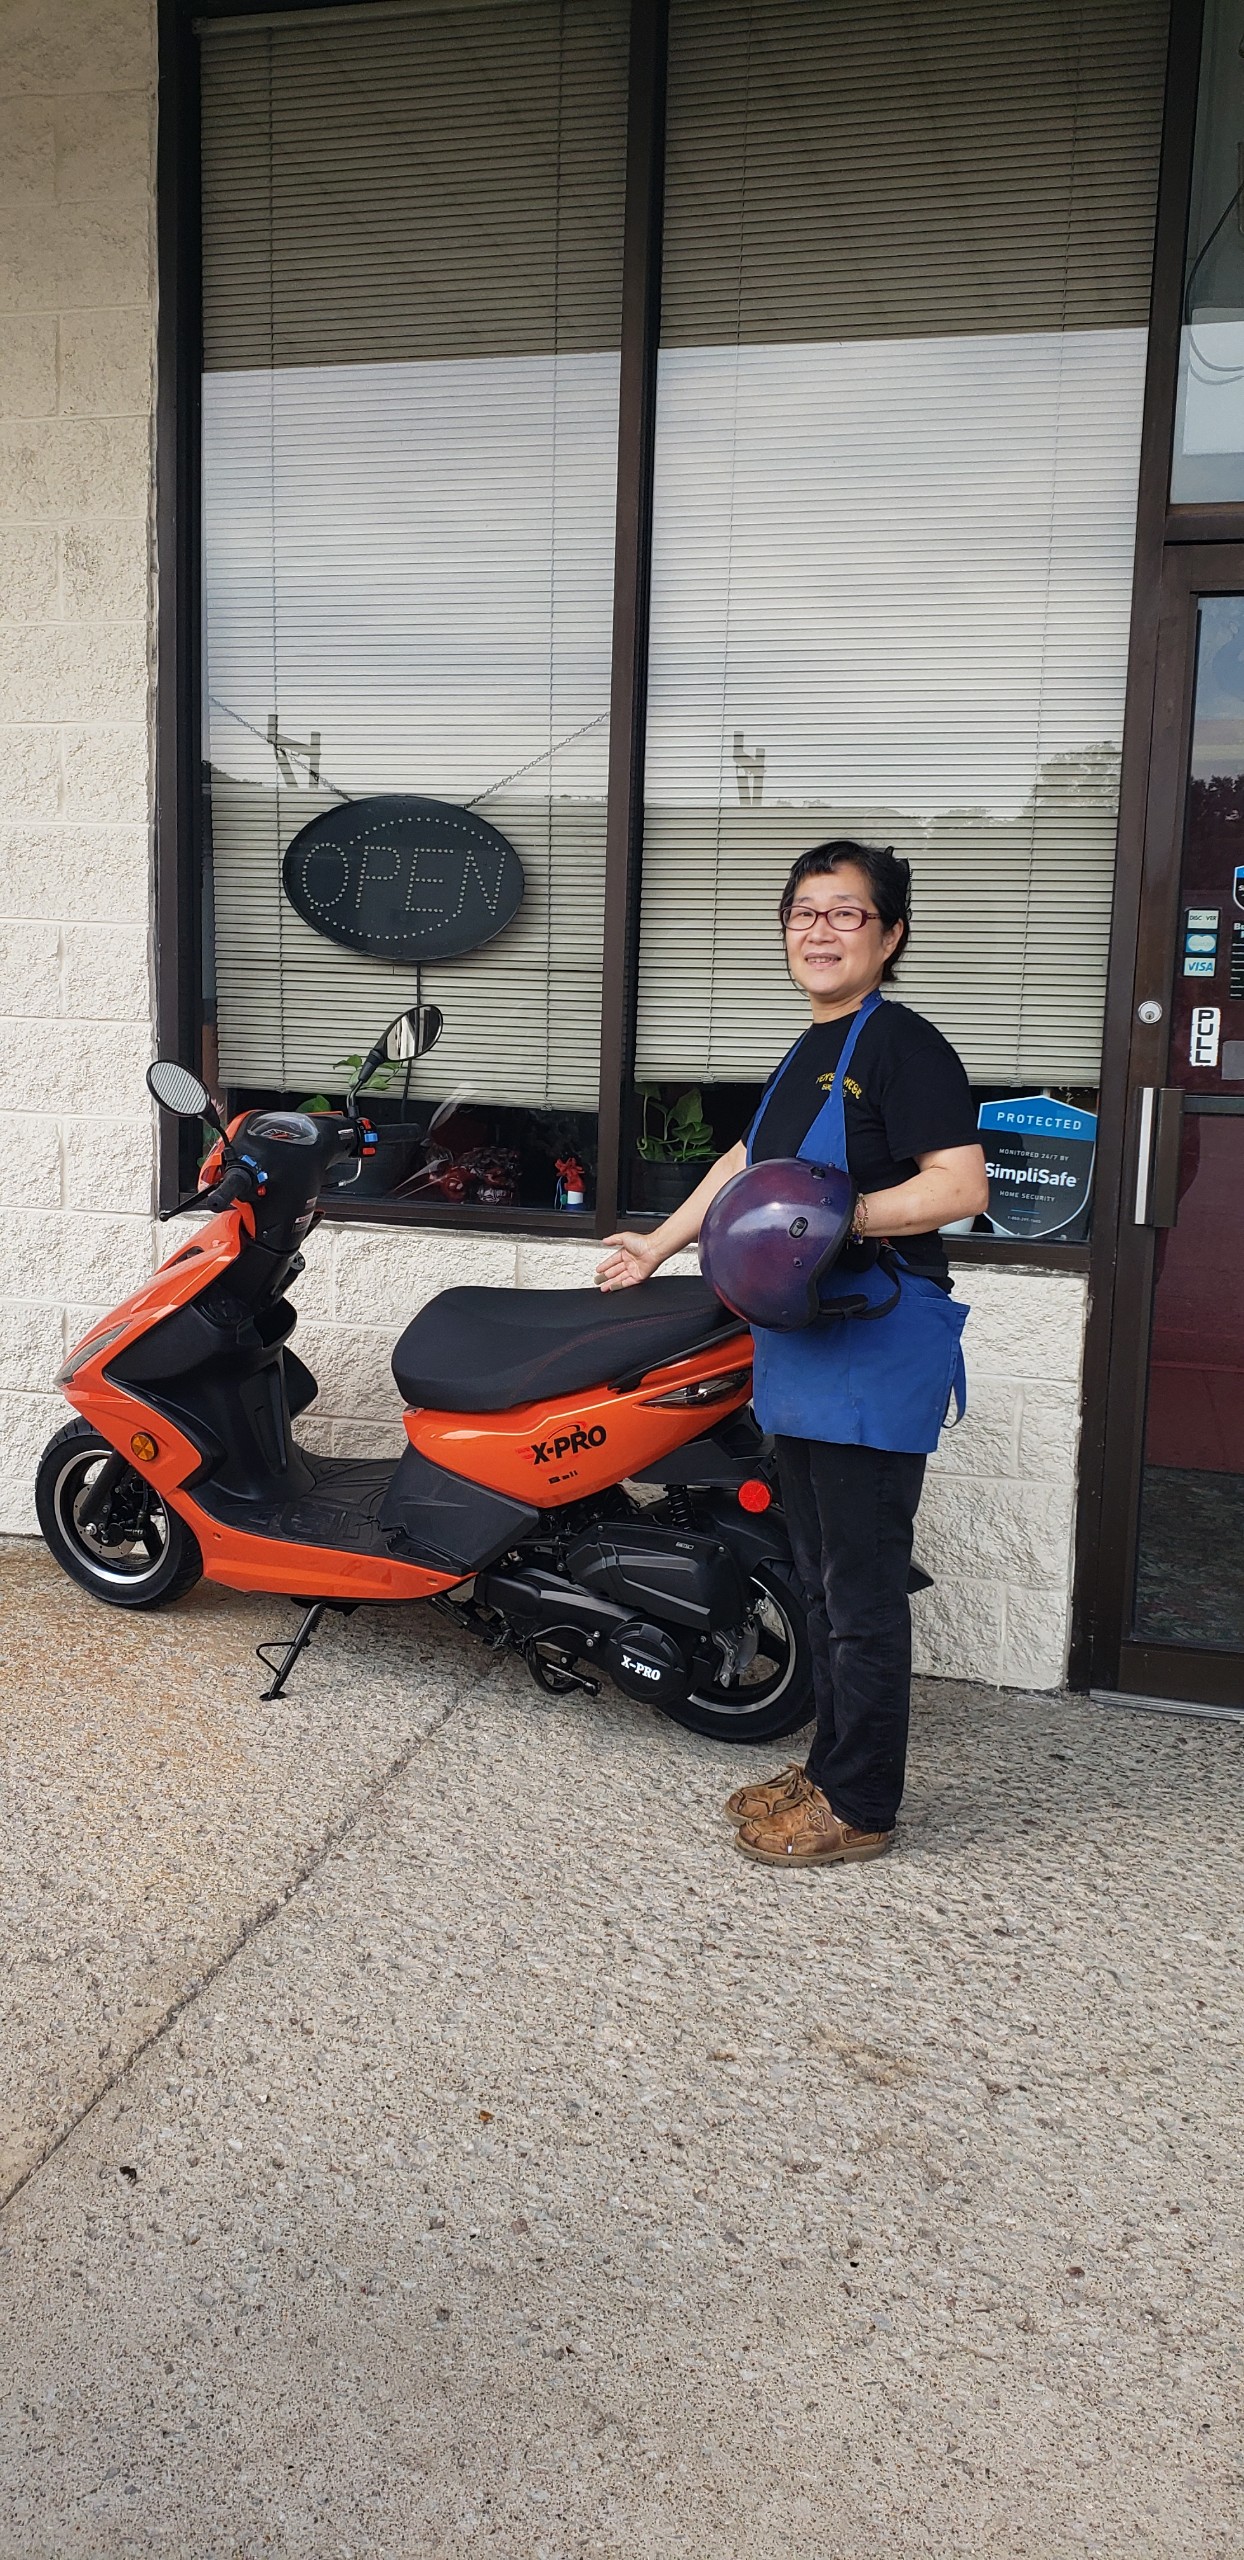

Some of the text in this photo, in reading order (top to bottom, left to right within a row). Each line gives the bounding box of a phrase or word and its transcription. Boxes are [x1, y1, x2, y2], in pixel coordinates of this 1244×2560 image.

[302, 842, 507, 916] OPEN
[1189, 961, 1214, 972] VISA
[1195, 1010, 1214, 1063] PULL
[996, 1112, 1082, 1131] PROTECTED
[999, 1148, 1039, 1159] MONITORED
[985, 1162, 1077, 1187] SimpliSafe
[1000, 1190, 1055, 1202] HOME SECURITY
[531, 1425, 607, 1465] X-PRO
[621, 1654, 661, 1681] X-PRO
